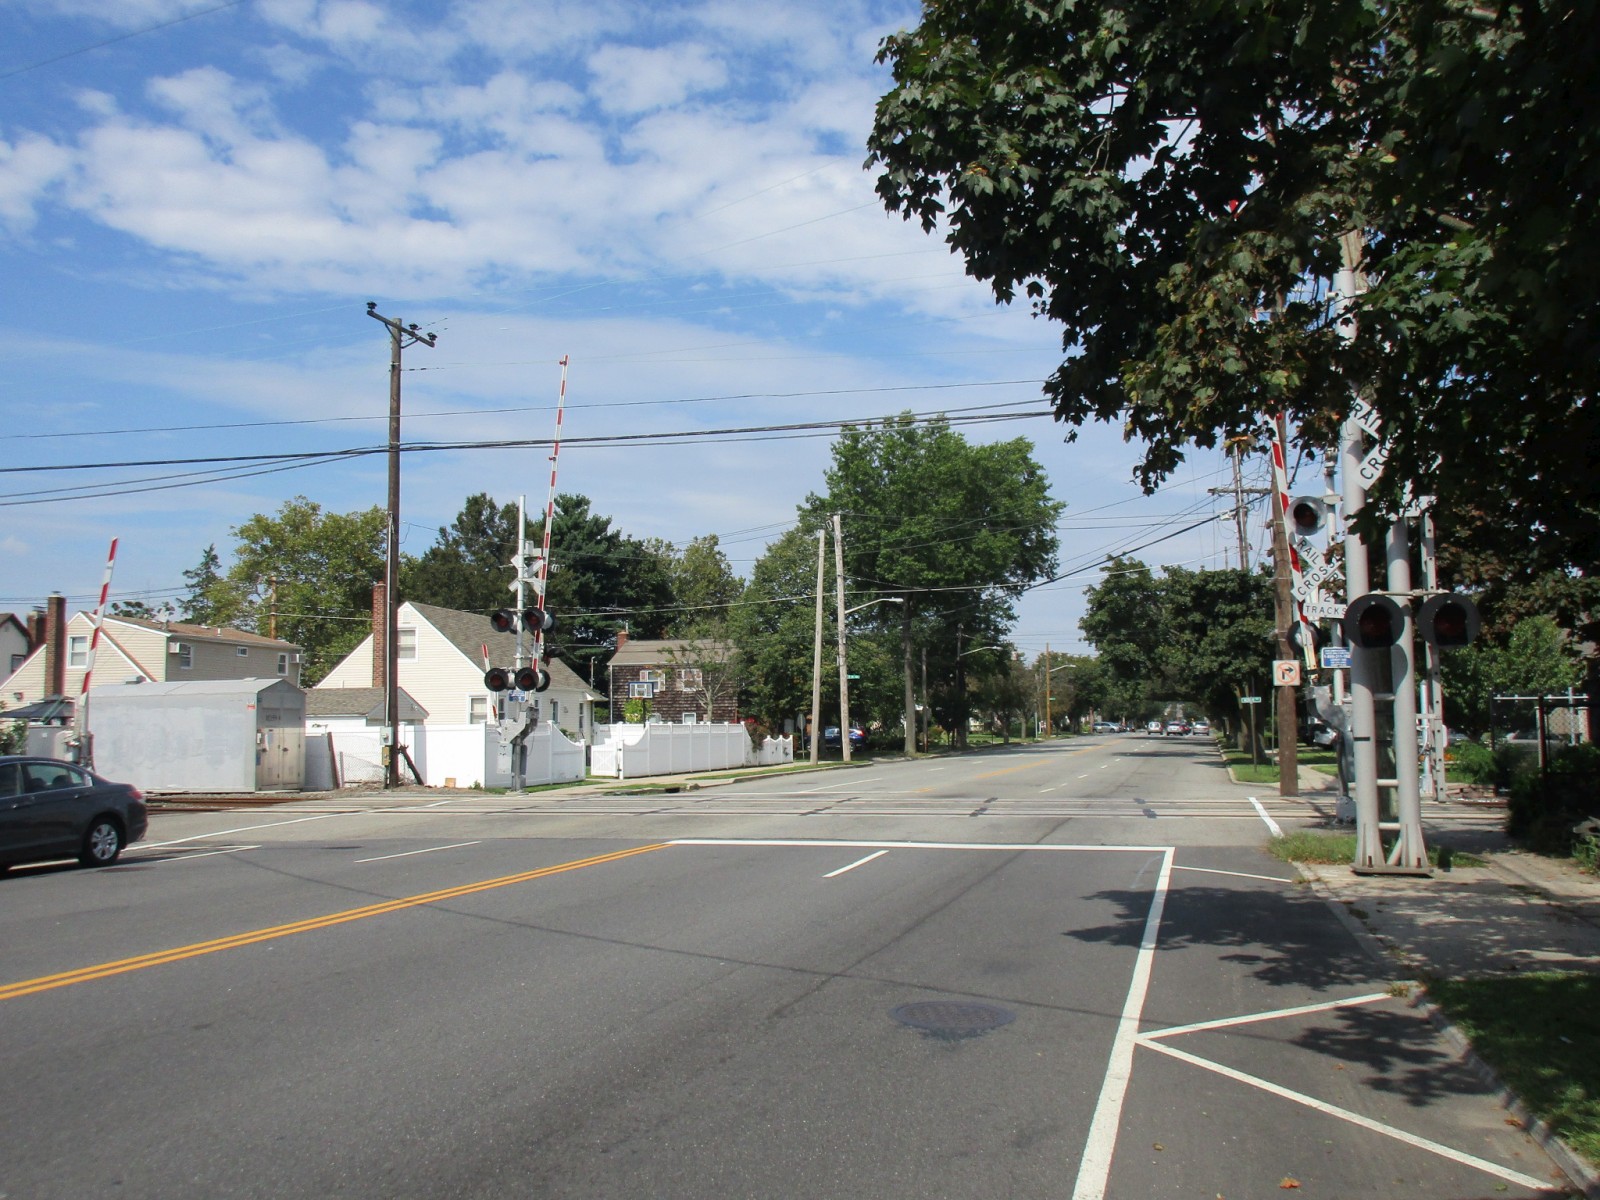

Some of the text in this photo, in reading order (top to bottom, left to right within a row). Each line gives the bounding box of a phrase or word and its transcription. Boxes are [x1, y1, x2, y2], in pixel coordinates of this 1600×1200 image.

[1353, 402, 1382, 430] RAI
[1297, 539, 1319, 565] RAIL
[1323, 591, 1331, 603] 2
[1305, 604, 1348, 615] TRACKS
